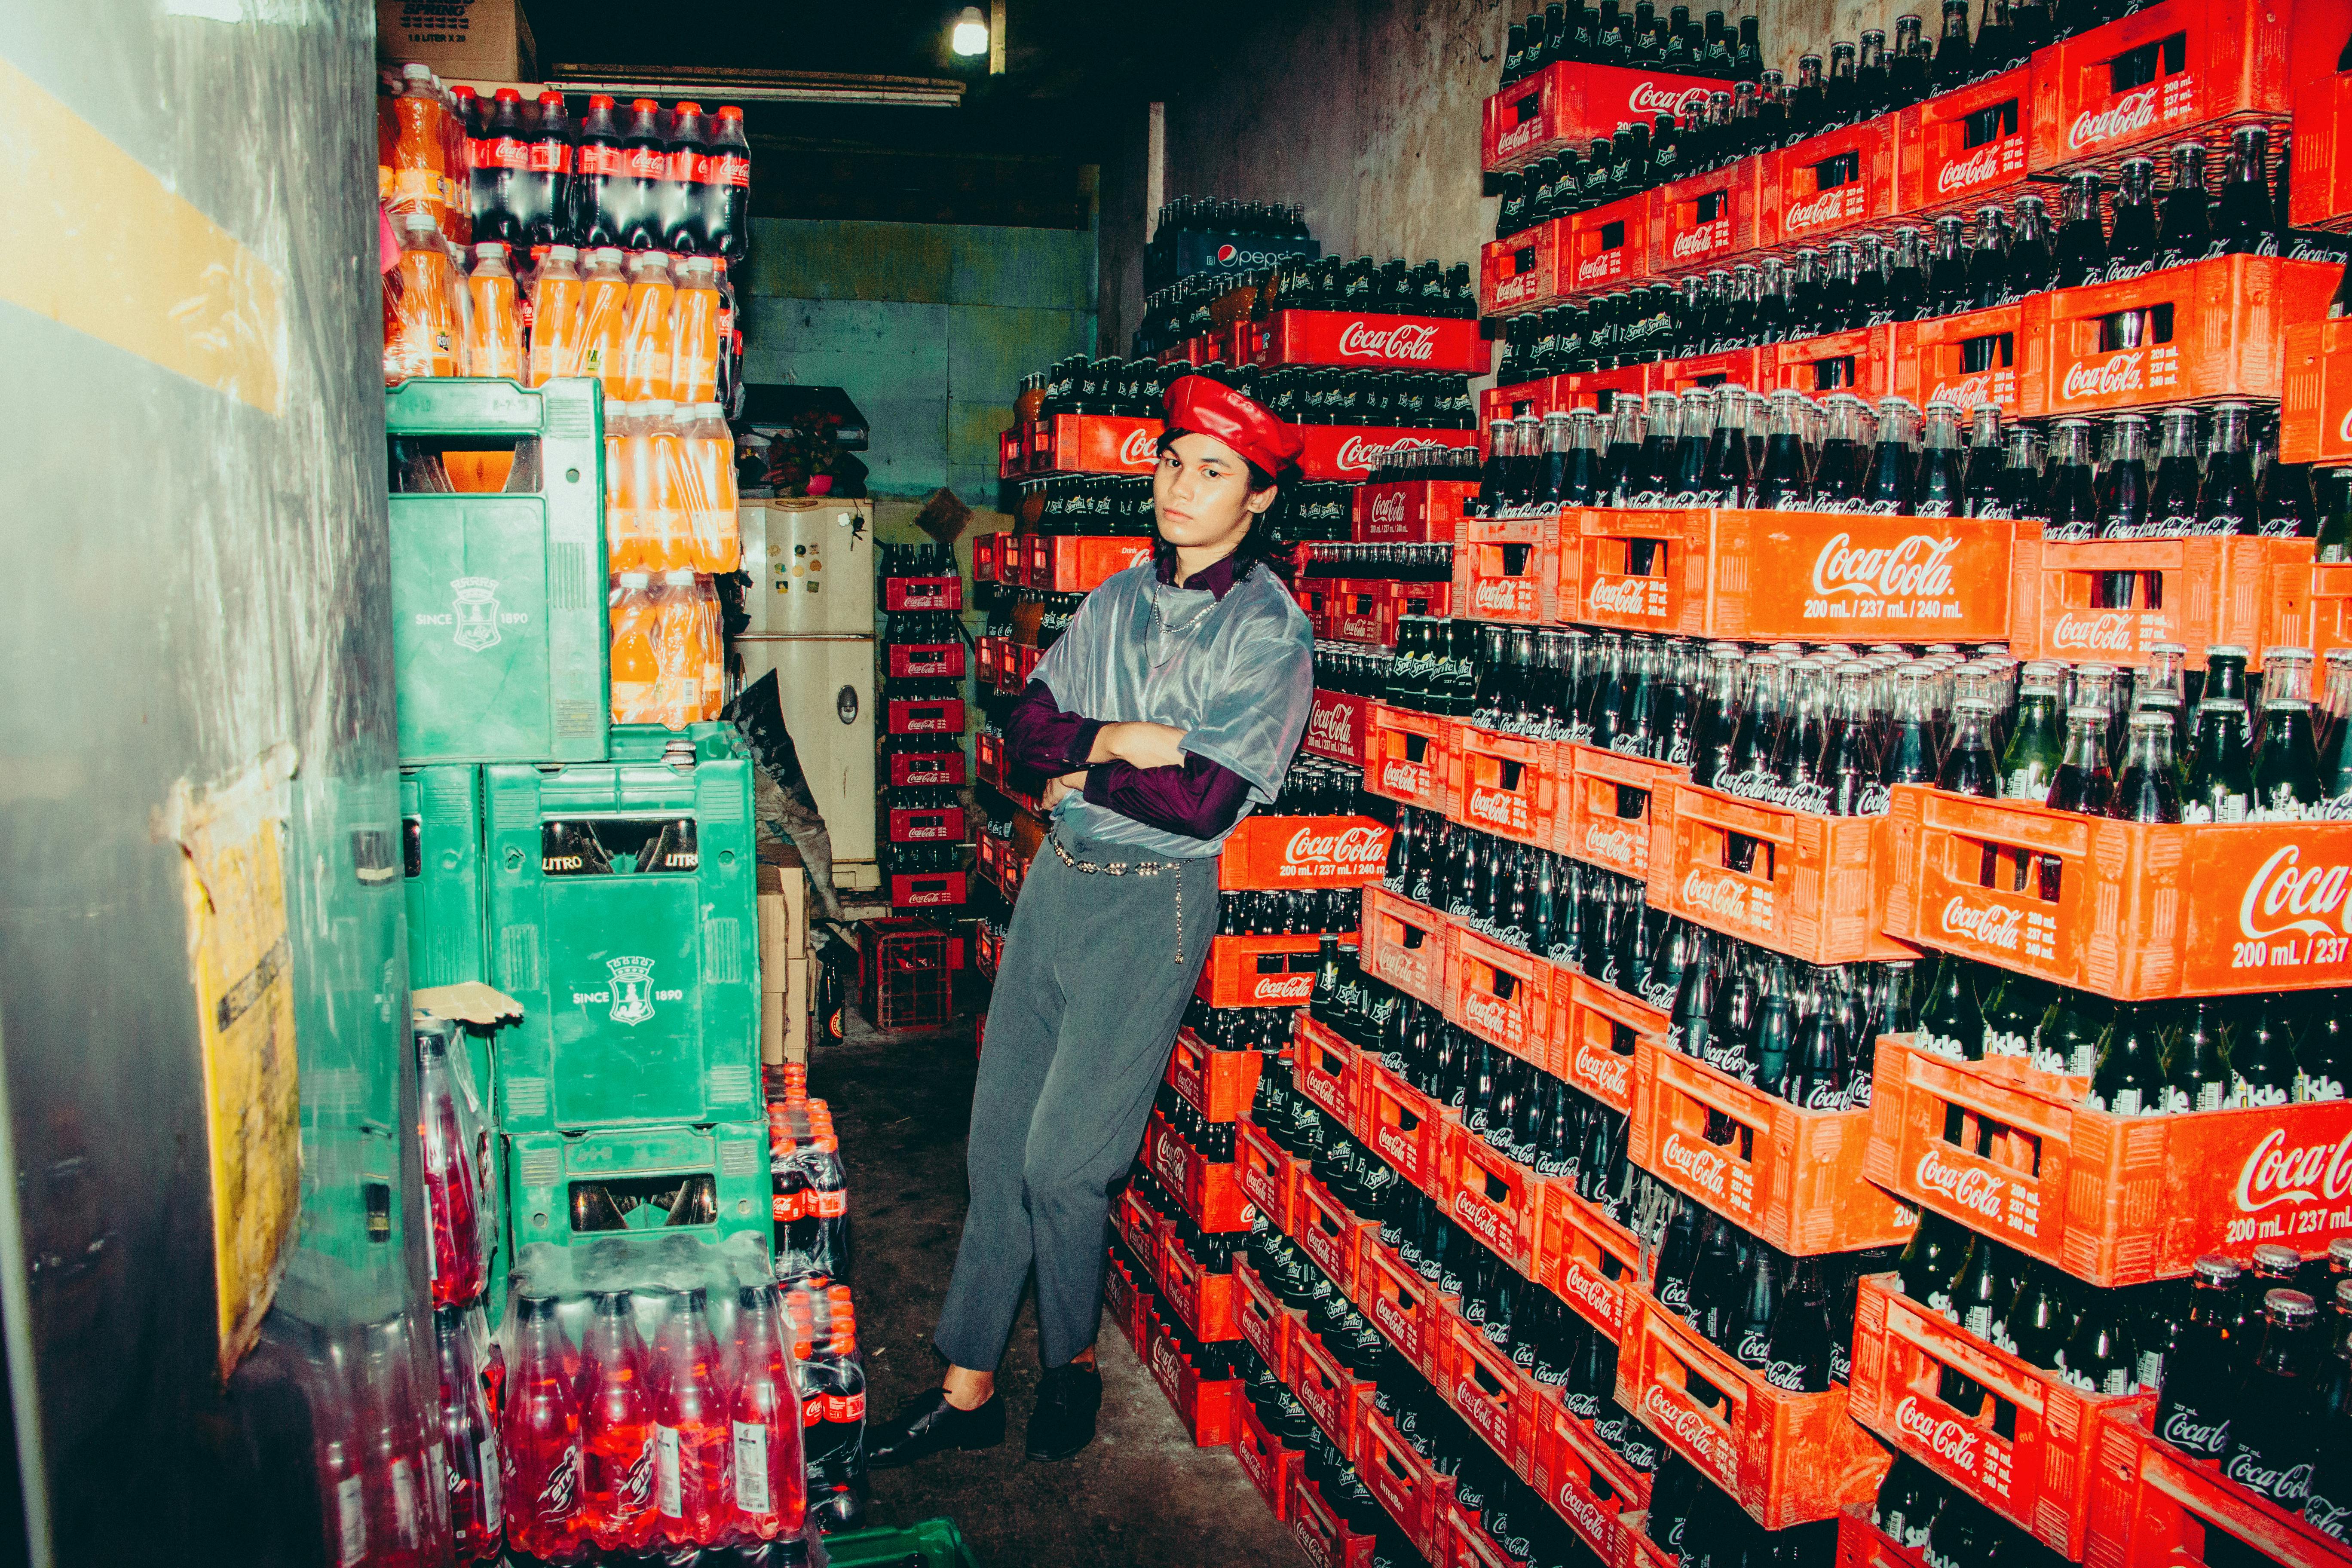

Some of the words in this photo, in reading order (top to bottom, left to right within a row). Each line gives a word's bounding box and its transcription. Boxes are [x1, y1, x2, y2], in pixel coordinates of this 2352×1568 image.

[403, 4, 465, 16] SPRING
[2164, 93, 2178, 106] 237
[2180, 89, 2193, 101] mL
[2165, 80, 2178, 93] 200
[2180, 76, 2193, 88] mL
[2068, 88, 2158, 150] Coca-Cola
[2164, 107, 2178, 119] 240
[2179, 102, 2193, 114] mL
[1498, 121, 1531, 155] Coca-Cola
[2004, 138, 2014, 149] 200
[2015, 136, 2024, 146] mL
[1938, 145, 2000, 193] Coca-Cola
[2003, 150, 2014, 161] 237
[2015, 147, 2024, 157] mL
[2003, 161, 2013, 172] 240
[2015, 159, 2023, 168] mL
[1786, 190, 1844, 232] Coca-Cola
[1673, 224, 1714, 258] Coca-Cola
[1579, 254, 1608, 281] Coca-Cola
[1497, 276, 1525, 303] Coca-Cola
[1339, 322, 1439, 360] Coca-Cola
[2151, 348, 2165, 359] 200
[2165, 346, 2179, 357] mL
[2063, 352, 2144, 400] Coca-Cola
[2150, 362, 2164, 373] 237
[2165, 360, 2178, 371] mL
[2150, 376, 2164, 387] 240
[2164, 374, 2177, 385] mL
[1372, 492, 1406, 522] Coca-Cola
[1813, 533, 1961, 596] Coca-Cola
[1476, 579, 1516, 609] Coca-Cola
[1590, 577, 1647, 616] Coca-Cola
[1804, 600, 1828, 617] 200
[1830, 600, 1850, 618] mL
[1860, 600, 1885, 617] 237
[1887, 600, 1908, 618] mL
[1917, 600, 1940, 618] 240
[1943, 601, 1963, 618] mL
[415, 613, 452, 625] SINCE
[501, 613, 528, 623] 1890
[1344, 618, 1366, 637] Coca-Cola
[2053, 612, 2134, 651] Coca-Cola
[2140, 628, 2153, 638] 237
[2154, 628, 2166, 639] mL
[2141, 615, 2153, 625] 200
[908, 663, 935, 673] Coca-Cola
[908, 720, 935, 730] Coca-Cola
[1309, 700, 1354, 743] Coca-Cola
[907, 774, 937, 783] Coca-Cola
[1384, 761, 1418, 793] Coca-Cola
[1470, 788, 1513, 825] Coca-Cola
[909, 828, 935, 837] Coca-Cola
[1286, 827, 1387, 864] Coca-Cola
[1586, 824, 1633, 862] Coca-Cola
[542, 856, 582, 870] LITRO
[1280, 866, 1296, 876] 200
[1298, 865, 1312, 875] mL
[1319, 865, 1335, 875] 237
[1337, 864, 1352, 875] mL
[1359, 864, 1375, 874] 240
[1377, 865, 1385, 874] m
[909, 893, 938, 903] Coca-Cola
[1683, 869, 1747, 919] Coca-Cola
[1942, 896, 2024, 949] Coca-Cola
[2027, 927, 2042, 940] 237
[2043, 932, 2055, 944] mL
[2028, 912, 2042, 925] 200
[2043, 917, 2057, 929] mL
[1380, 946, 1412, 982] Coca-Cola
[2026, 942, 2040, 957] 240
[2041, 948, 2055, 960] mL
[2233, 942, 2266, 968] 200
[2271, 940, 2300, 965] mL
[2315, 938, 2349, 963] 237
[573, 992, 609, 1004] SINCE
[655, 990, 683, 1001] 1890
[1255, 977, 1312, 998] Coca-Cola
[1467, 993, 1507, 1033] Coca-Cola
[1576, 1045, 1628, 1098] Coca-Cola
[1307, 1070, 1335, 1108] Coca-Cola
[1379, 1127, 1406, 1162] Coca-Cola
[1663, 1133, 1727, 1194] Coca-Cola
[1732, 1166, 1743, 1180] 200
[1744, 1174, 1754, 1186] mL
[2236, 1128, 2352, 1212] Coca-C
[1246, 1169, 1266, 1201] Coca-Cola
[1731, 1179, 1743, 1193] 237
[1743, 1188, 1752, 1200] mL
[1917, 1151, 2006, 1217] Coca-Cola
[2011, 1183, 2026, 1199] 200
[2027, 1192, 2040, 1206] mL
[1455, 1191, 1498, 1237] Coca-Cola
[1730, 1193, 1741, 1207] 240
[1742, 1202, 1752, 1213] mL
[2009, 1199, 2025, 1214] 237
[2025, 1207, 2039, 1222] mL
[2008, 1214, 2023, 1230] 240
[2024, 1223, 2037, 1237] mL
[2226, 1218, 2255, 1244] 200
[2259, 1215, 2285, 1238] mL
[2298, 1209, 2328, 1233] 237
[2330, 1206, 2352, 1229] mL
[1307, 1227, 1330, 1262] Coca-Cola
[1566, 1265, 1611, 1317] Coca-Cola
[1243, 1311, 1261, 1350] Coca-Cola
[1376, 1297, 1406, 1340] Coca-Cola
[1302, 1380, 1326, 1421] Coca-Cola
[1457, 1381, 1492, 1432] Coca-Cola
[2174, 1403, 2186, 1412] 237
[1645, 1384, 1711, 1457] Coca-Cola
[1896, 1396, 1978, 1470] Coca-Cola
[1985, 1442, 1999, 1459] 200
[2000, 1454, 2013, 1468] mL
[1982, 1473, 1996, 1488] 240
[1997, 1483, 2010, 1498] mL
[1985, 1458, 1998, 1473] 237
[1999, 1468, 2011, 1483] mL
[1560, 1483, 1604, 1541] Coca-Cola
